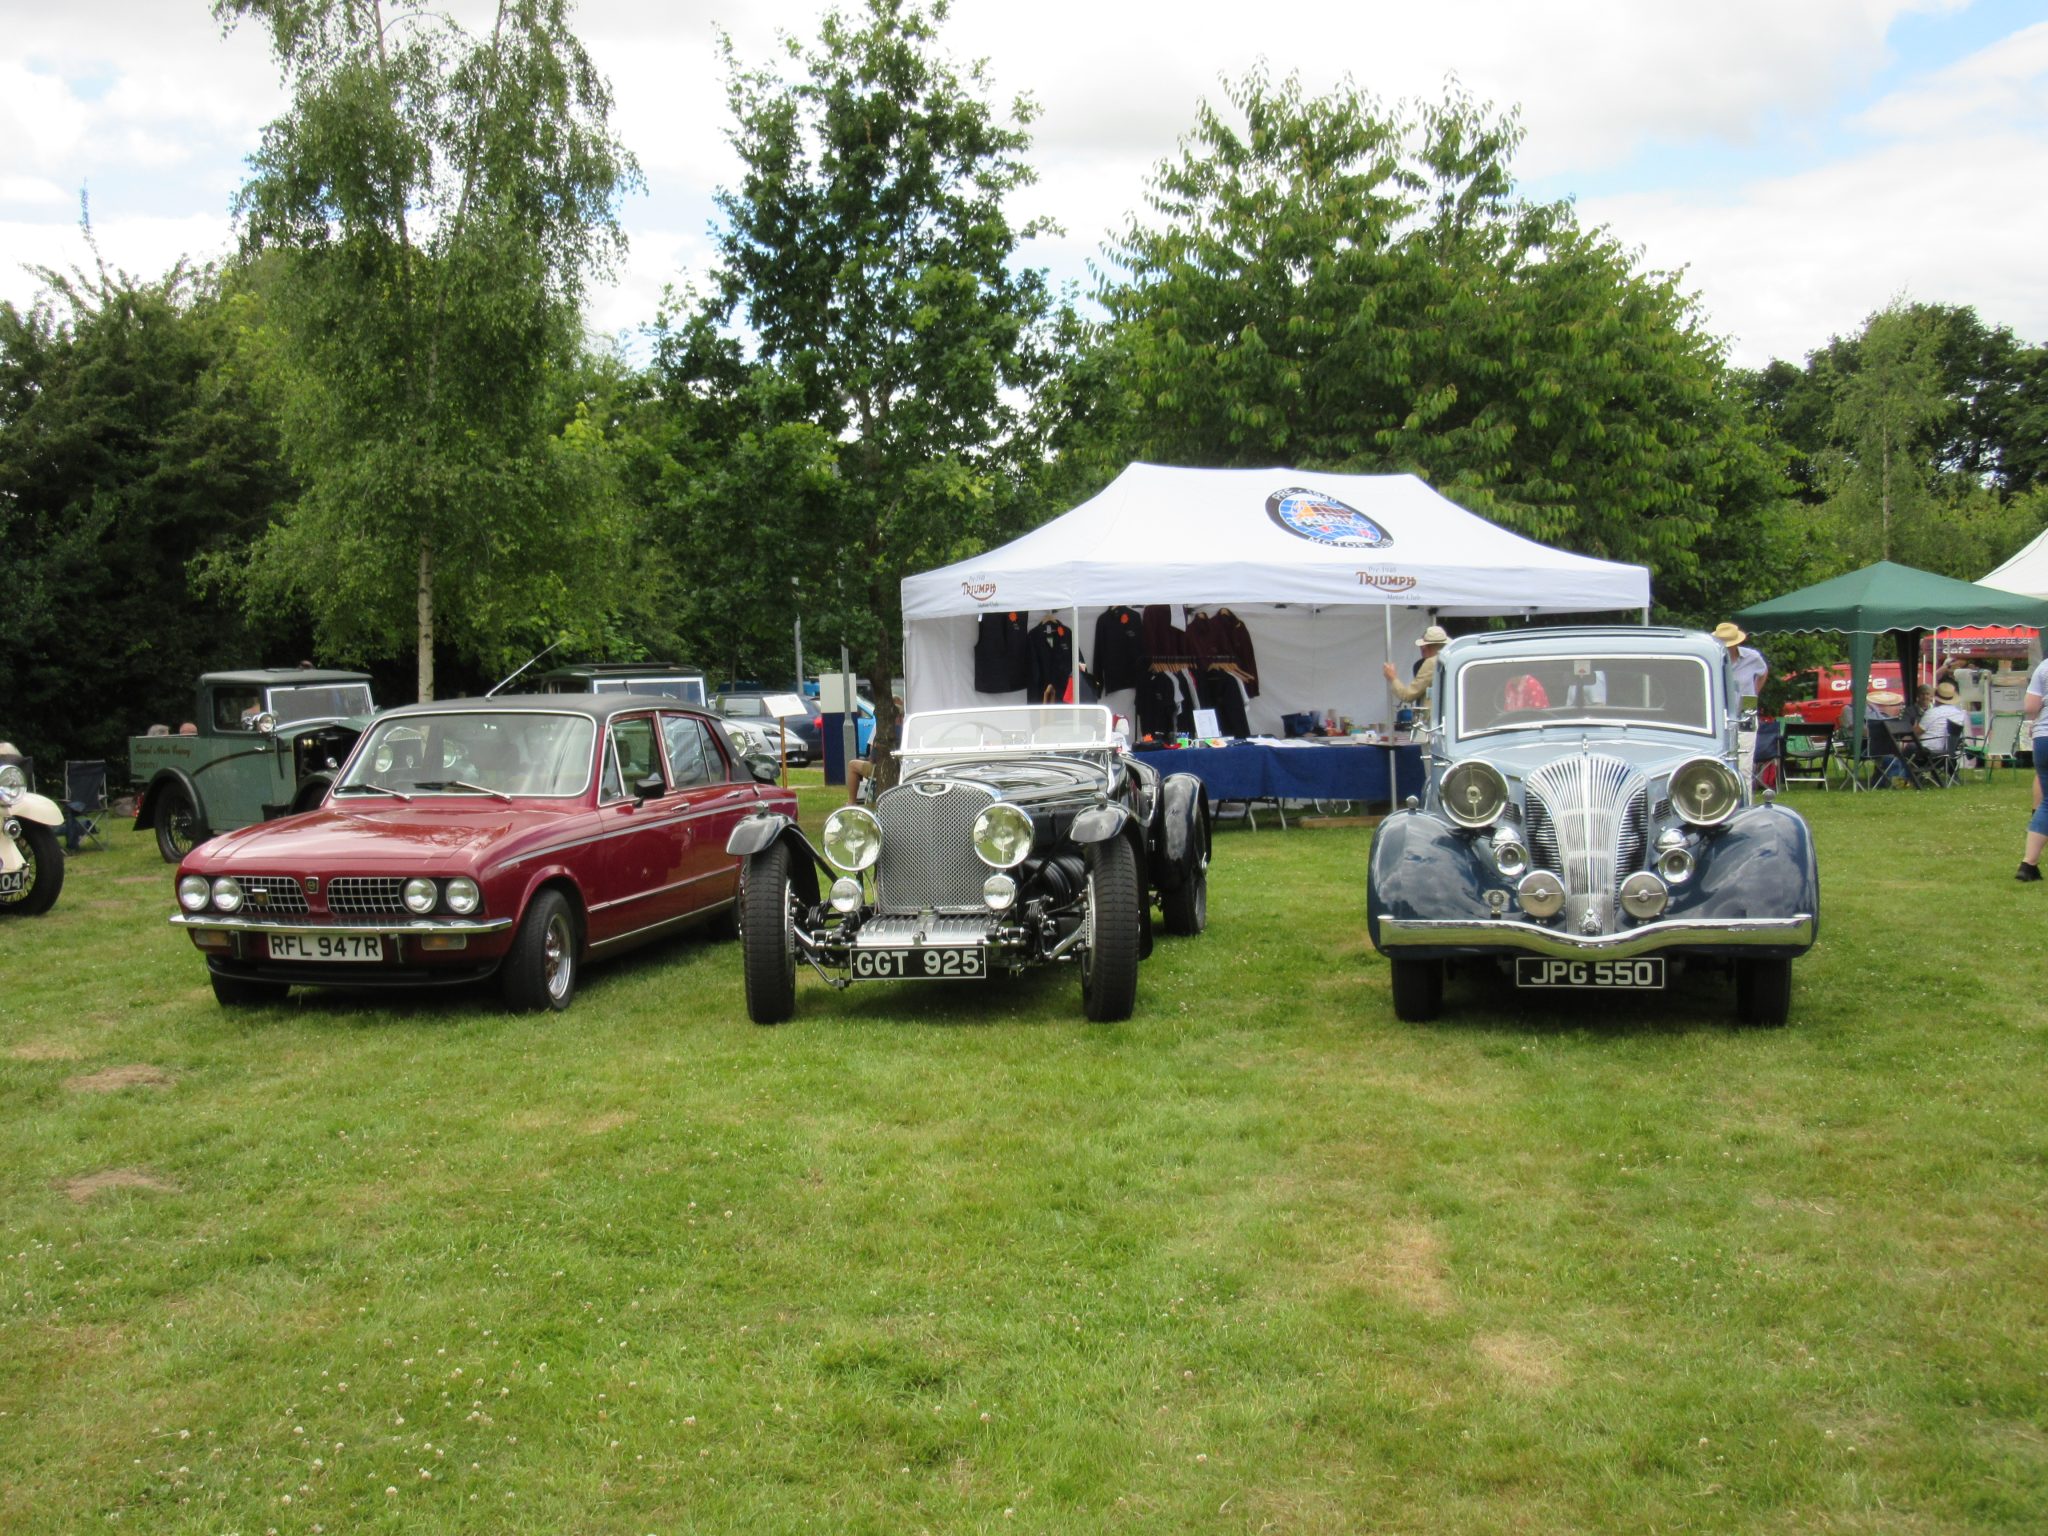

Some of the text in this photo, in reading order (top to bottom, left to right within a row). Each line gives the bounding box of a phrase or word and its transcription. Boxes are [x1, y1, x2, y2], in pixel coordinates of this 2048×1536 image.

[1272, 488, 1297, 501] PRE
[1308, 536, 1370, 549] MOTOR
[961, 581, 997, 601] TRIUMPH
[1355, 571, 1417, 593] TRIUMPH
[0, 873, 21, 890] 04
[271, 936, 379, 957] RFL 947R
[857, 950, 980, 976] GGT 925
[1531, 961, 1653, 985] JPG 550
